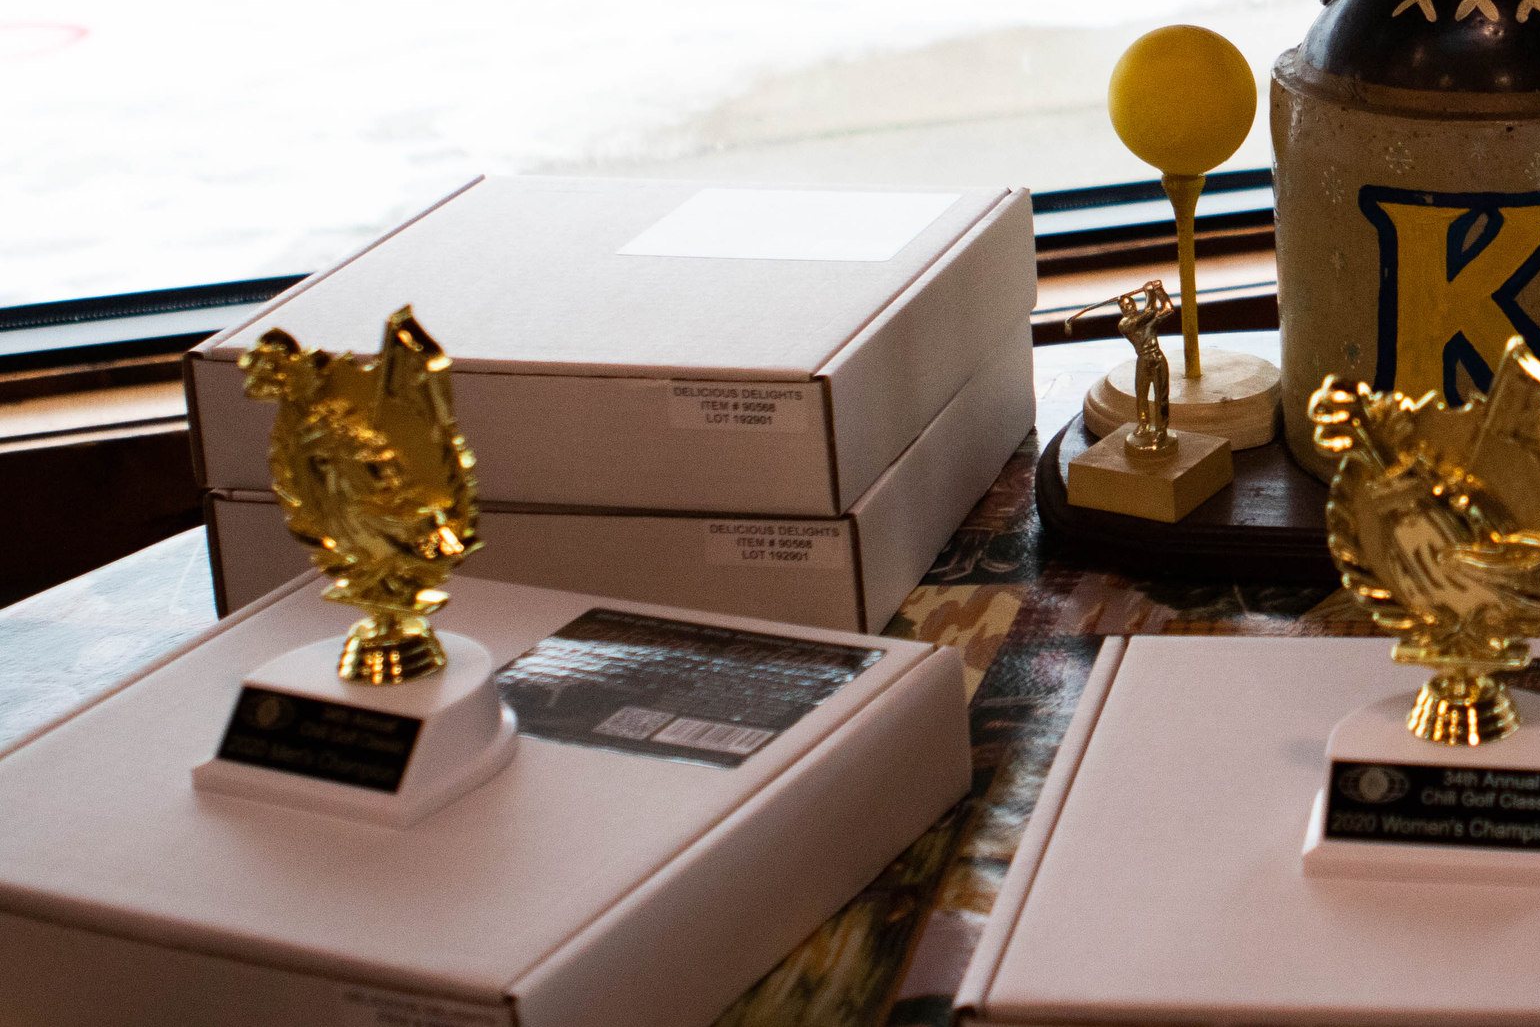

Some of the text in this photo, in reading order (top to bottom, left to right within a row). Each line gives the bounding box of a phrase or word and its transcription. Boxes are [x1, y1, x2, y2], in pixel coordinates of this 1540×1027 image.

[673, 386, 803, 401] DELICIOUS DELIGHTS
[701, 401, 729, 411] ITEM
[706, 414, 730, 424] LOT
[709, 524, 840, 538] DELICIOUS DELIGHTS
[737, 537, 765, 548] ITEM
[742, 550, 766, 560] LOT
[1482, 771, 1540, 791] Annual
[1460, 788, 1496, 808] Golf
[1331, 811, 1377, 833] 2020
[1380, 815, 1464, 837] Women's
